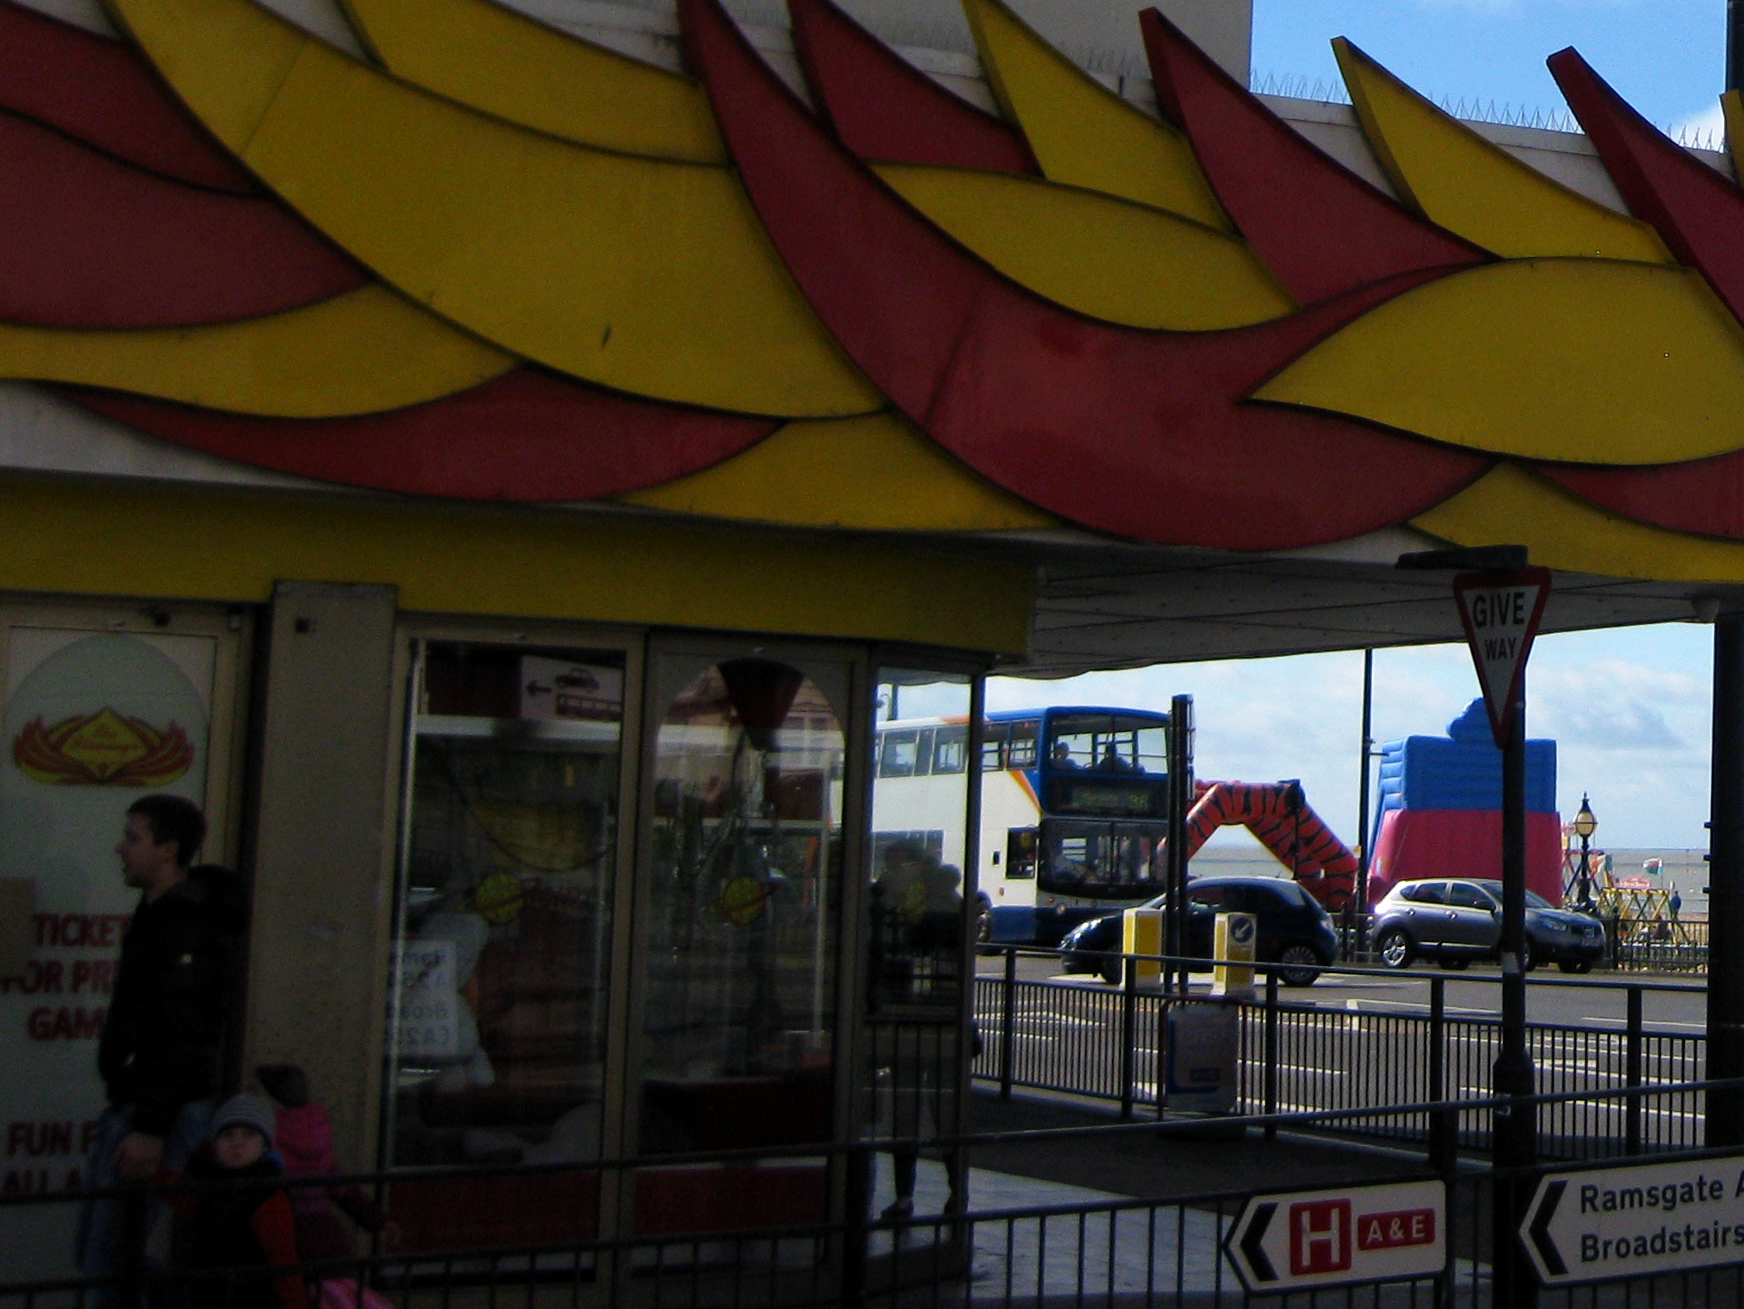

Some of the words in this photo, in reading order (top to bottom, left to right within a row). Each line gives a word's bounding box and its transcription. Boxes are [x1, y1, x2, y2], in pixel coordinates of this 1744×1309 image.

[1472, 591, 1526, 628] GIVE
[1484, 637, 1517, 661] WAY
[2, 959, 64, 994] OR
[8, 1120, 73, 1157] FUN
[1580, 1174, 1724, 1214] Ramsgate
[1300, 1207, 1341, 1268] H
